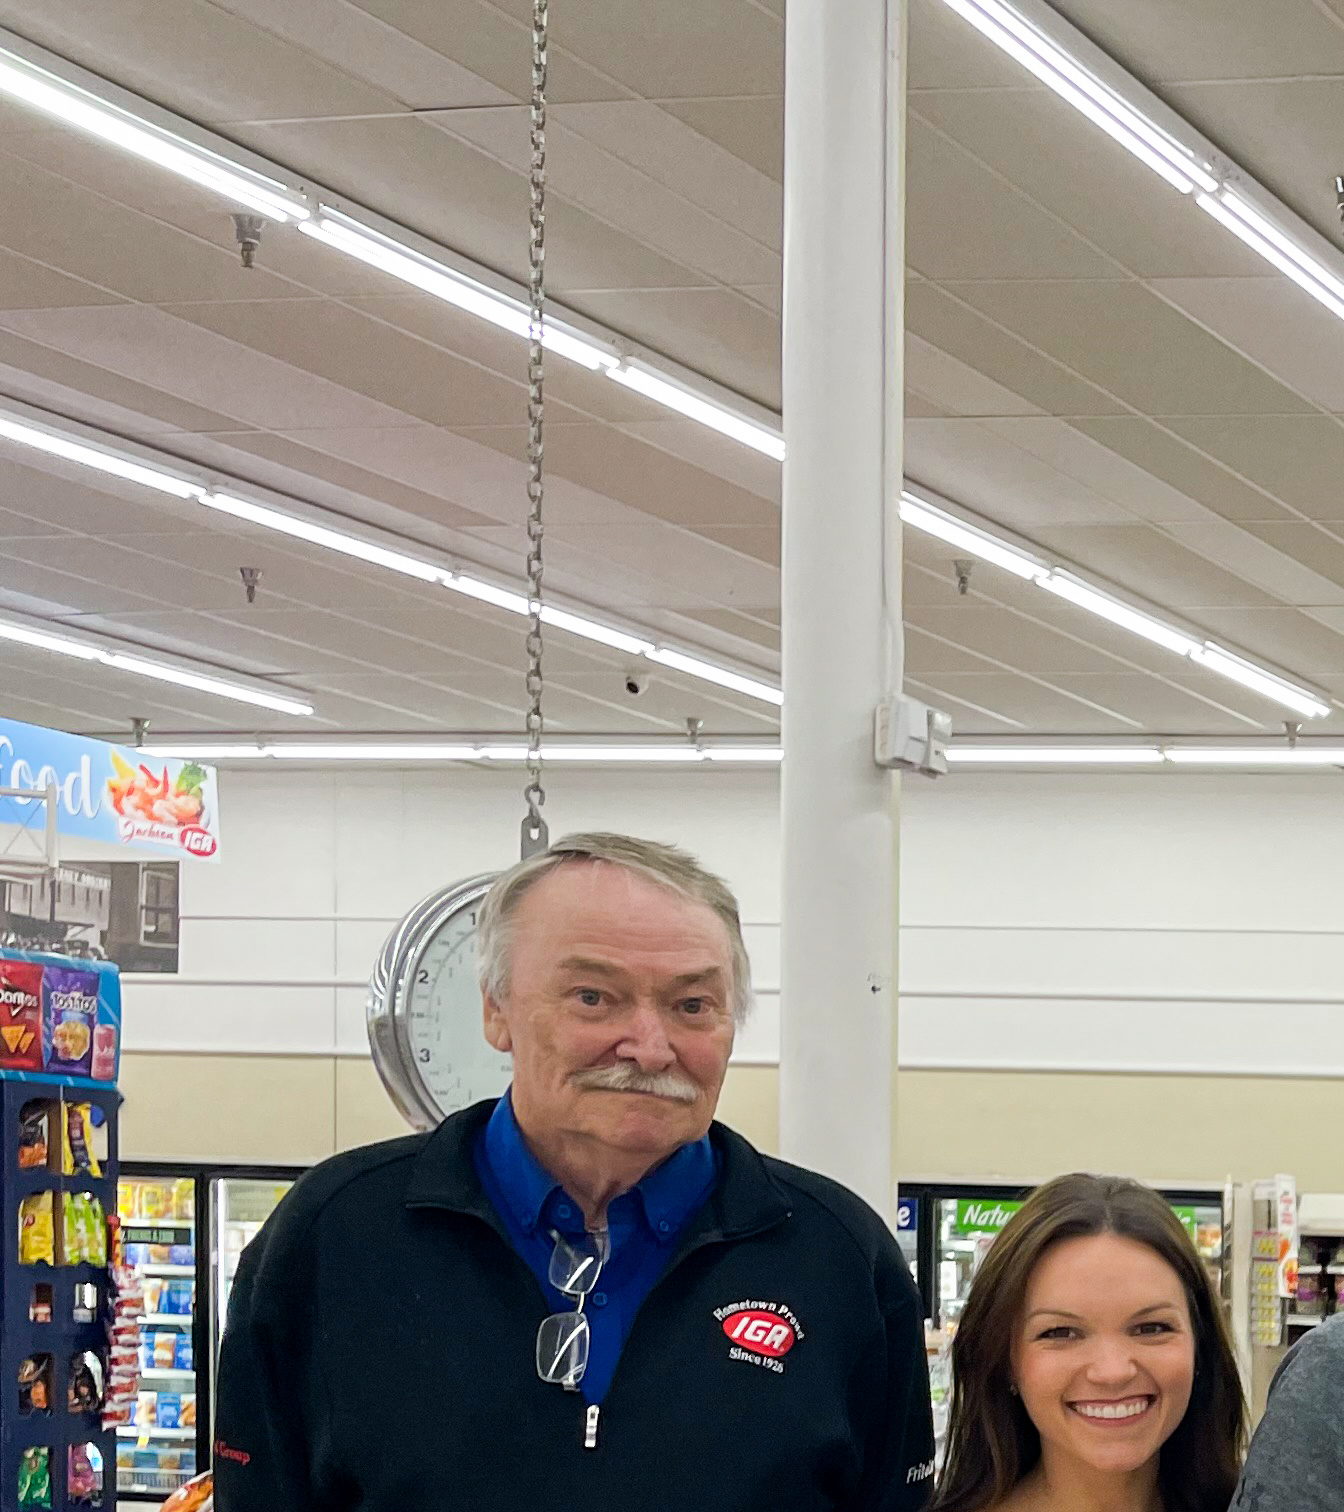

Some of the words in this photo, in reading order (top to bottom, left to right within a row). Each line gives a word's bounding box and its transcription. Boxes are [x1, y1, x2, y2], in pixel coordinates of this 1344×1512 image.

[0, 735, 102, 819] ood
[184, 831, 215, 852] IGA
[418, 969, 429, 984] 2
[419, 1048, 431, 1063] 3
[713, 1299, 776, 1321] Hometown
[778, 1304, 805, 1340] Proud
[731, 1316, 790, 1350] IGA
[728, 1347, 762, 1365] Since
